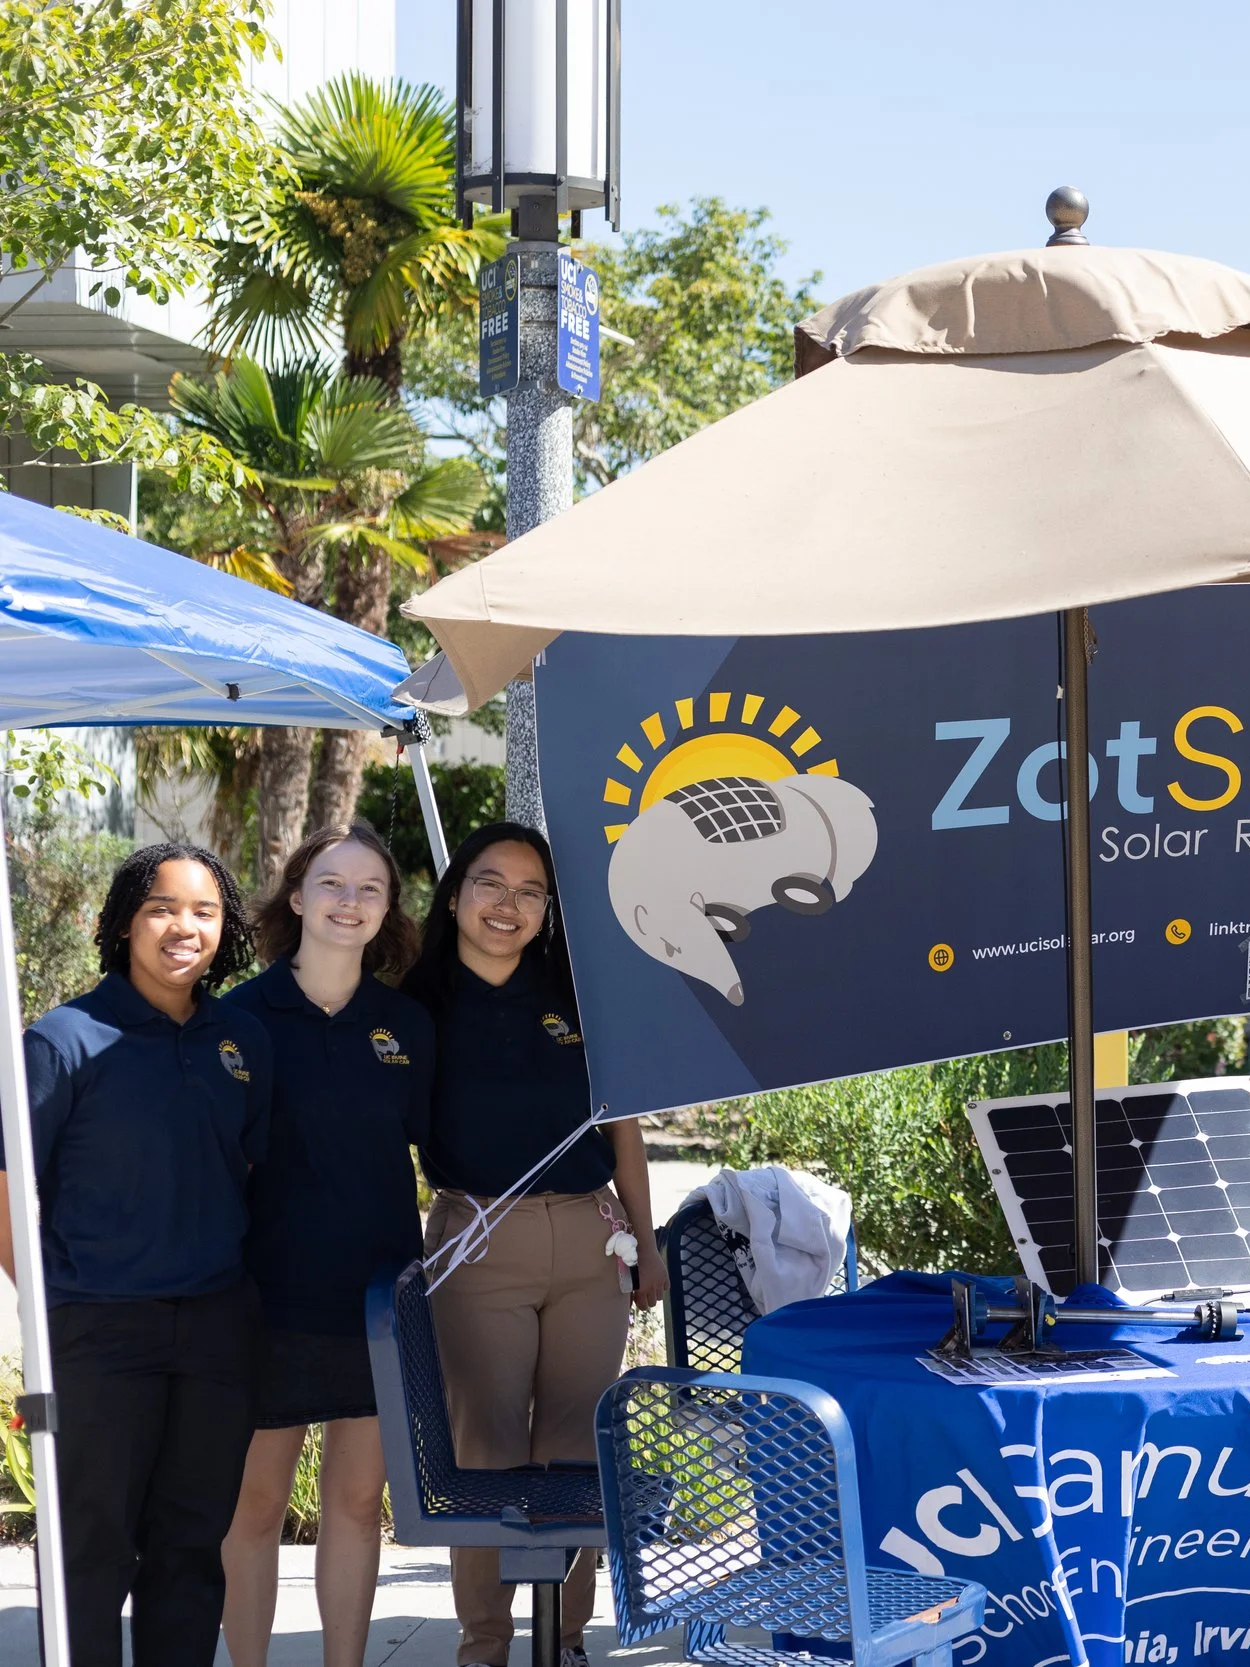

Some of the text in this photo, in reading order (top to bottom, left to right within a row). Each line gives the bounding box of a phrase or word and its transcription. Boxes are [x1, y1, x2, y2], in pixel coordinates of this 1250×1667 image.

[481, 268, 496, 291] UCI
[561, 258, 577, 285] UCI
[561, 294, 588, 320] TOBACCO
[481, 312, 509, 340] FREE
[560, 309, 590, 341] FREE
[1099, 824, 1208, 862] Solar
[972, 929, 1135, 960] www.ucisolar.org
